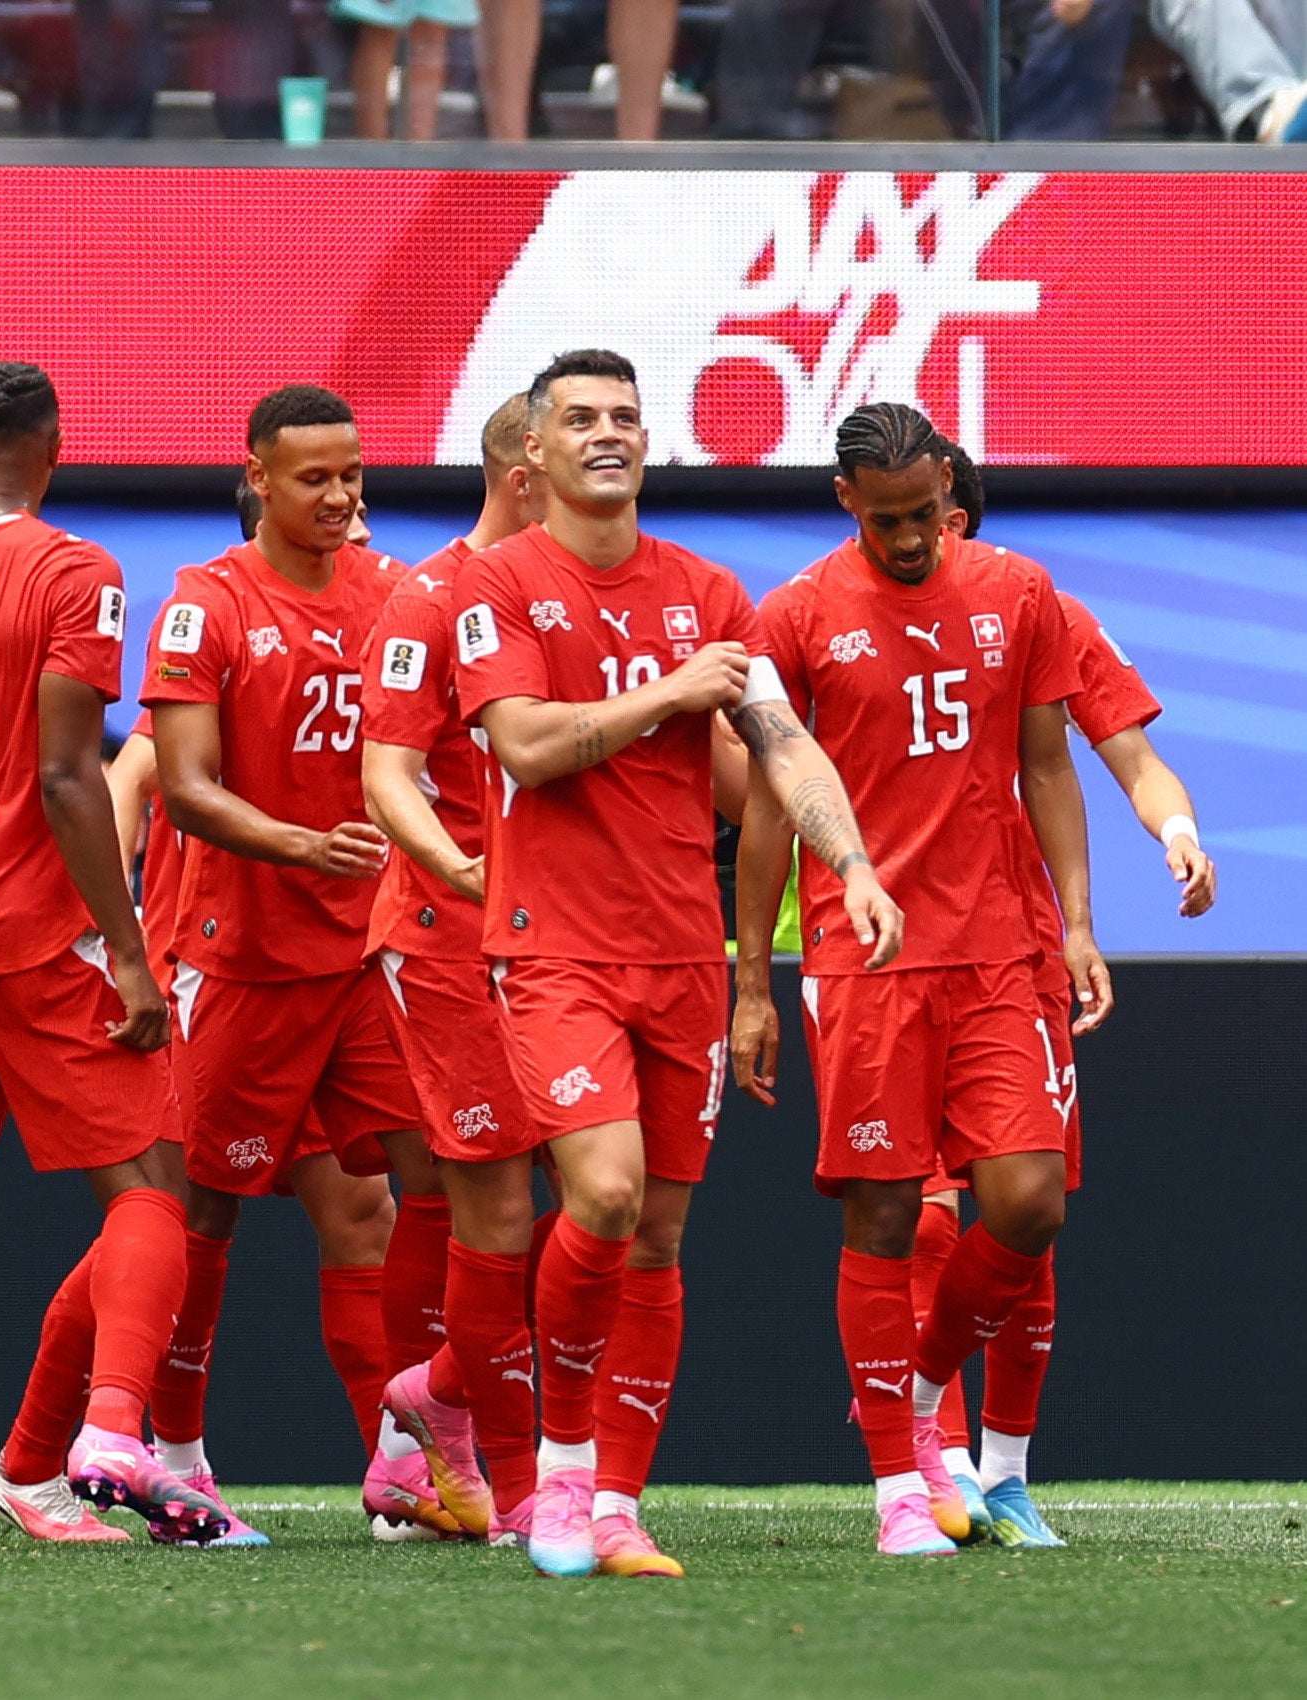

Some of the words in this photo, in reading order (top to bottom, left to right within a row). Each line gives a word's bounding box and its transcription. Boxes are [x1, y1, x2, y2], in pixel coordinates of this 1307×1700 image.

[294, 674, 362, 753] 25
[902, 669, 970, 757] 15
[855, 1359, 908, 1370] suisse
